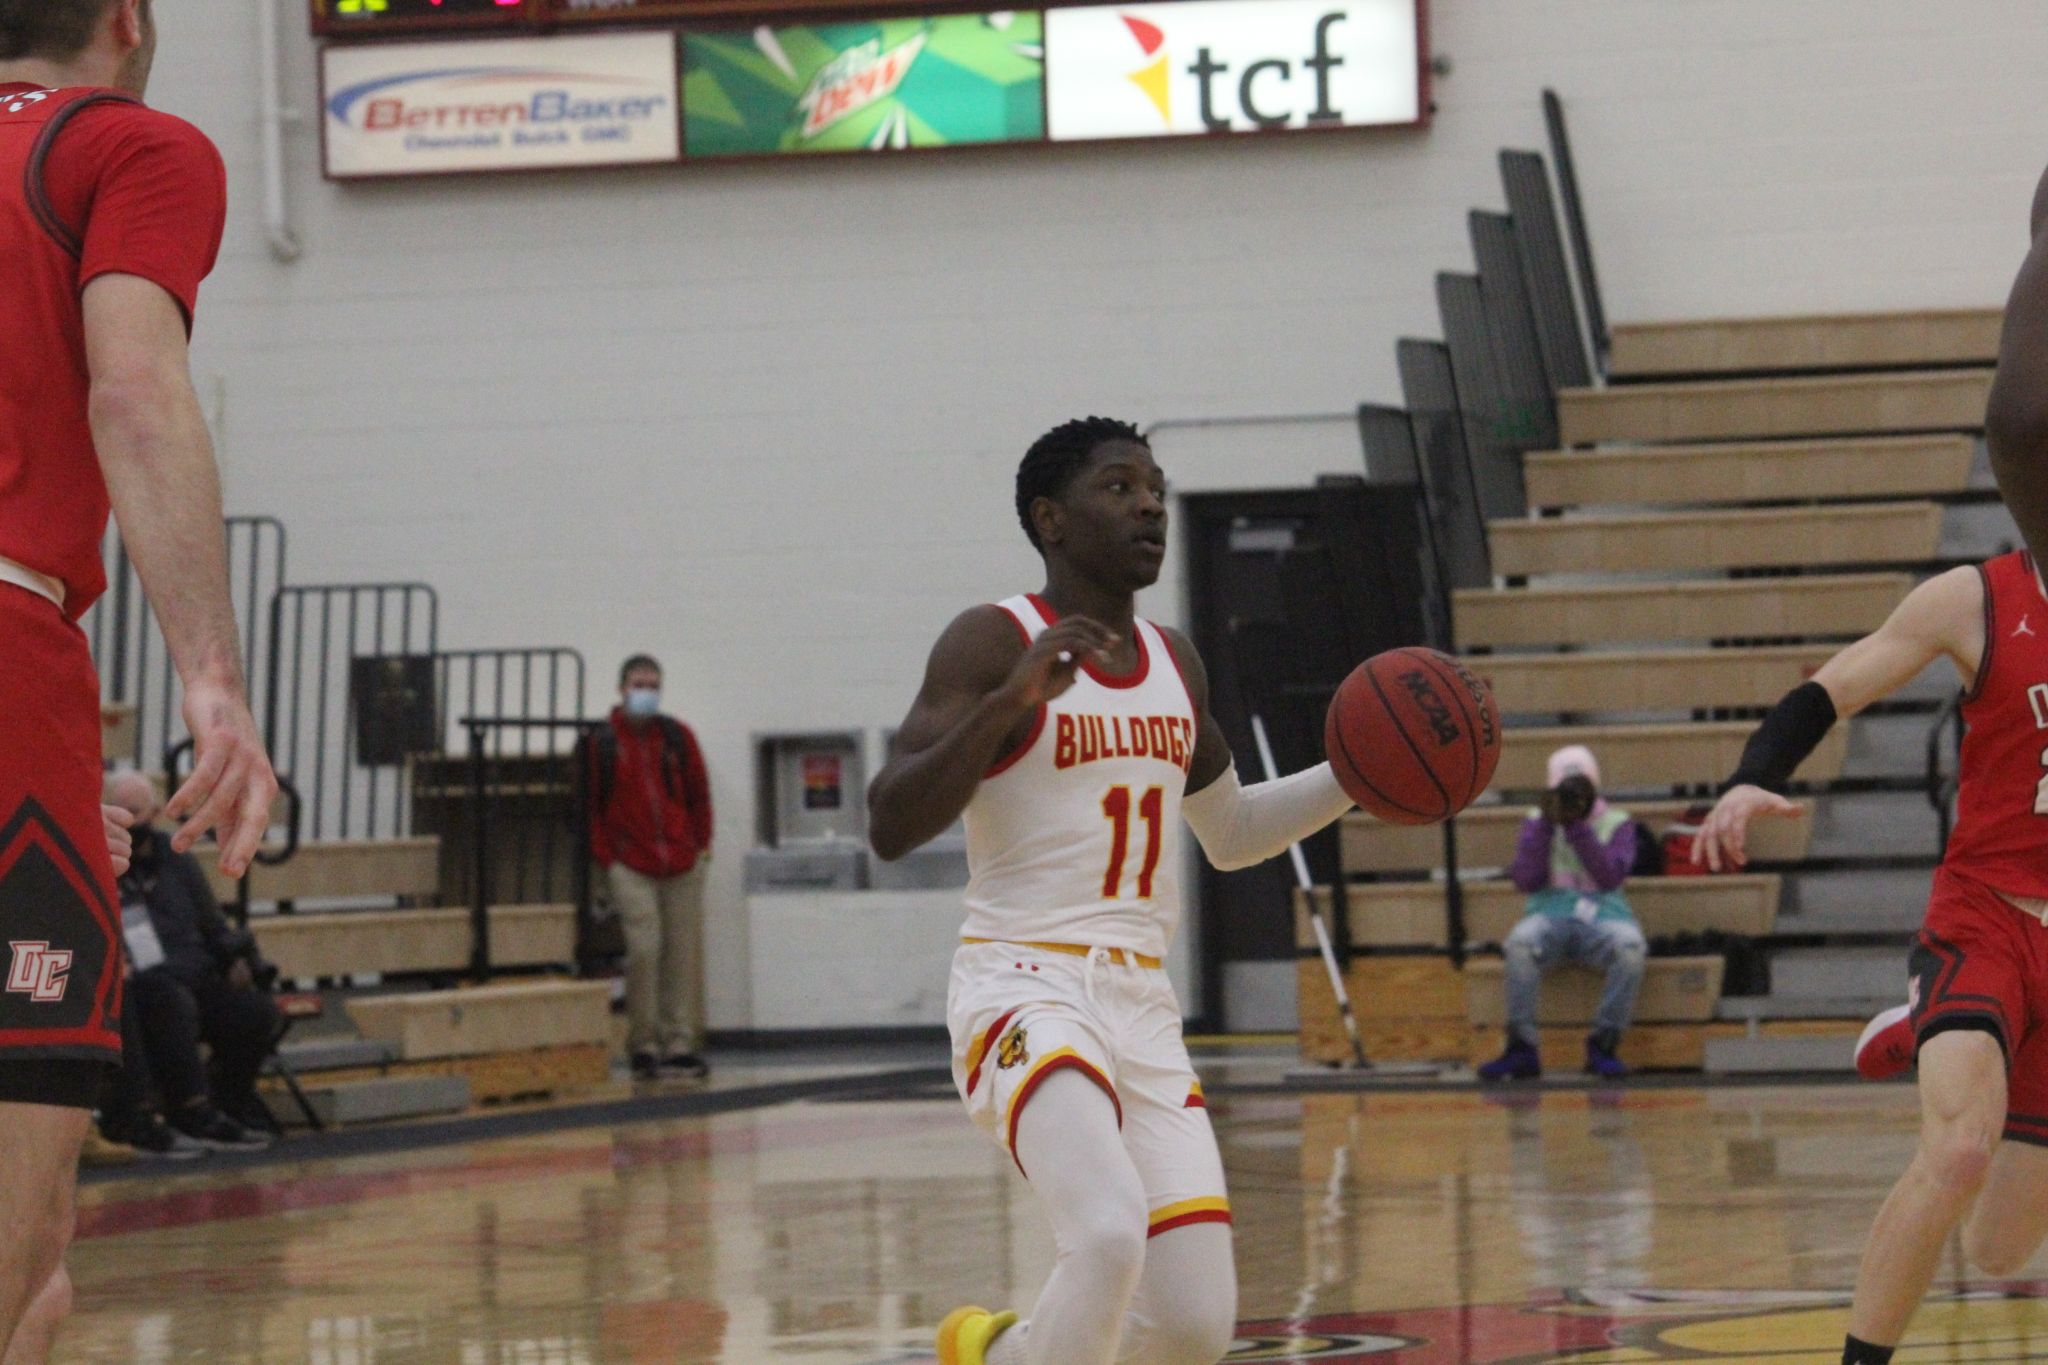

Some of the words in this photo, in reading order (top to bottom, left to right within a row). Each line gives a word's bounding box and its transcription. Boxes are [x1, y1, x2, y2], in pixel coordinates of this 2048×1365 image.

[1187, 12, 1347, 133] tcf
[1054, 713, 1191, 777] BULLDOGS
[1398, 671, 1461, 746] NCAA
[1101, 783, 1164, 899] 11
